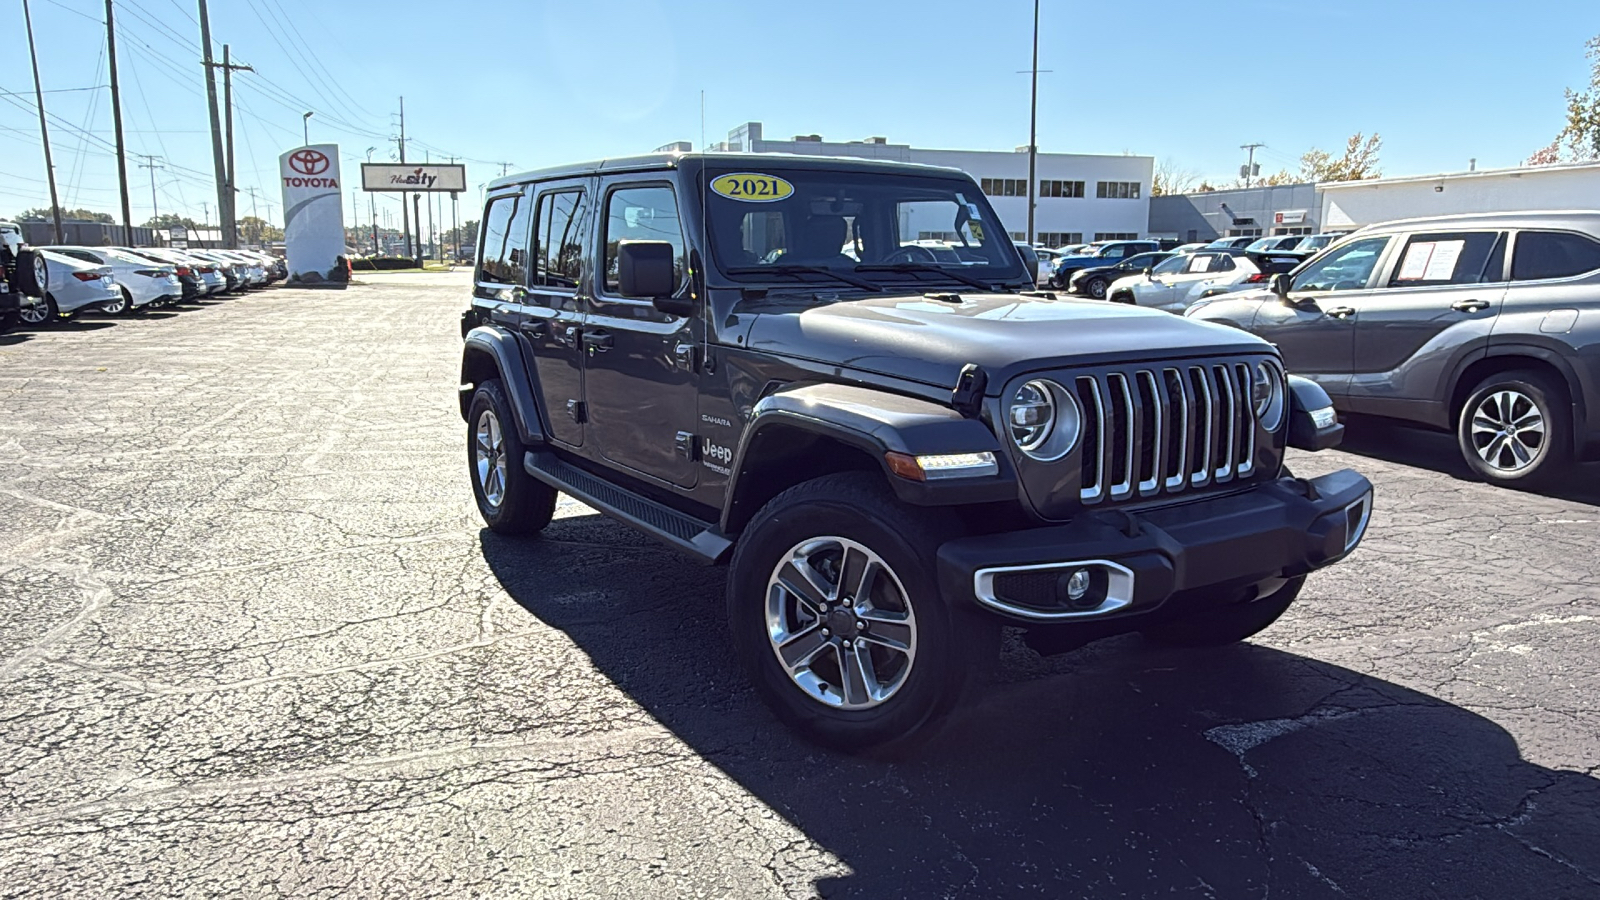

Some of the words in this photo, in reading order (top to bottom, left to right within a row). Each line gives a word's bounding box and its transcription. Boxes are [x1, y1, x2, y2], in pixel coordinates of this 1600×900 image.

[283, 177, 338, 189] TOYOTA
[727, 179, 780, 196] 2021
[701, 414, 732, 428] SAHARA
[702, 438, 732, 464] Jeep
